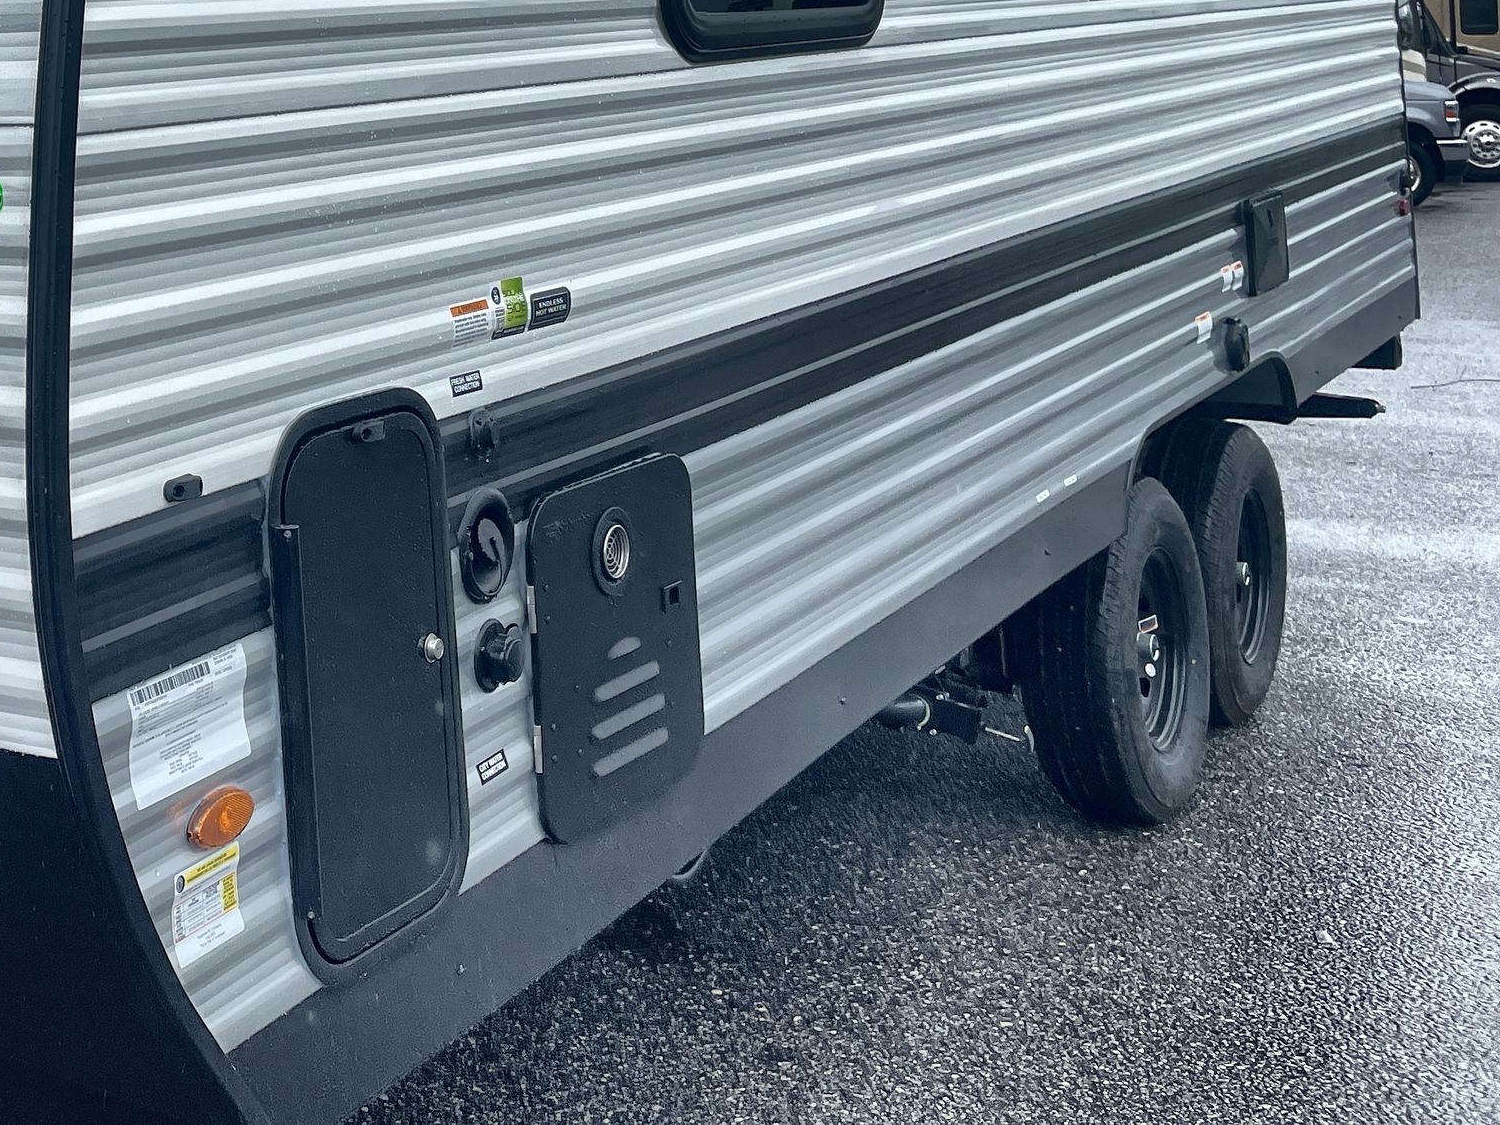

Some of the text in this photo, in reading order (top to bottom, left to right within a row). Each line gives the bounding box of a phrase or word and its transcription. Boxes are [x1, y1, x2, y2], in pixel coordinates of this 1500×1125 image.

[538, 296, 564, 309] ENDLESS
[548, 303, 567, 314] WATER
[454, 381, 481, 393] CONNECTION
